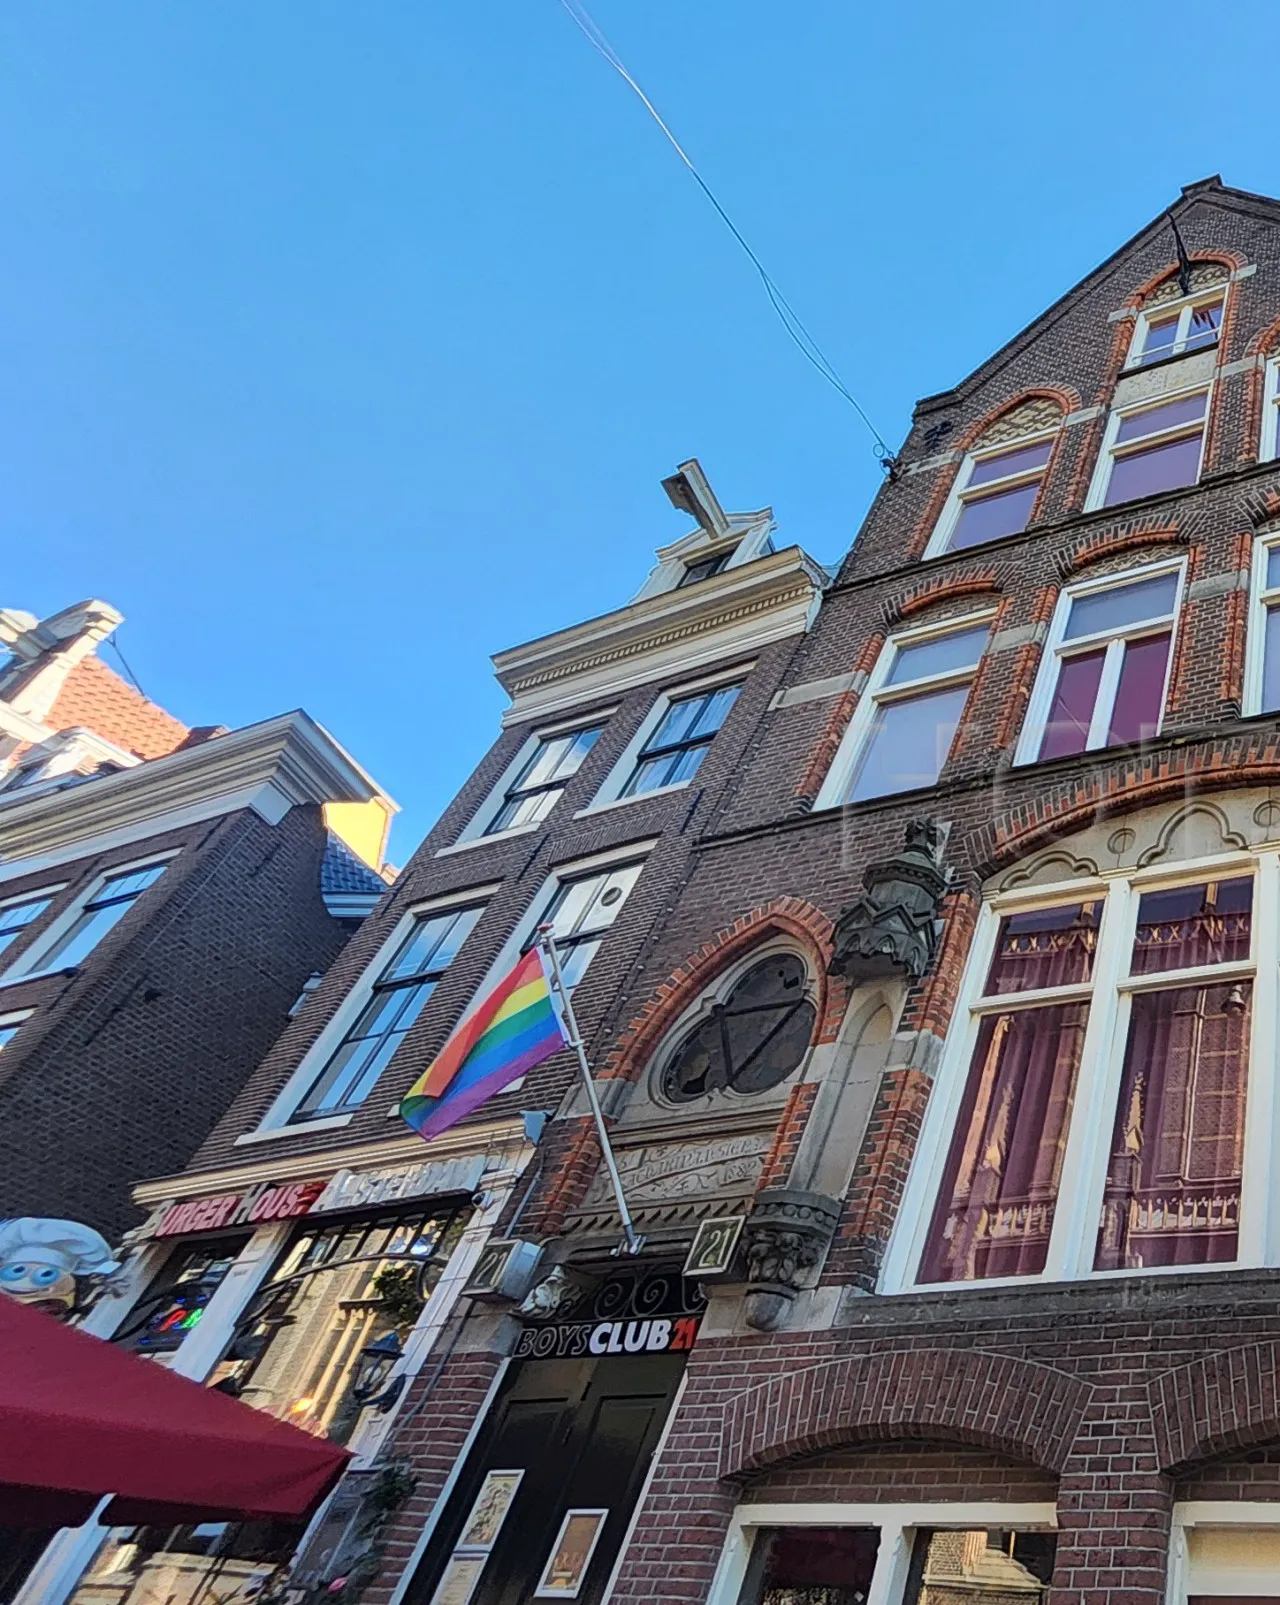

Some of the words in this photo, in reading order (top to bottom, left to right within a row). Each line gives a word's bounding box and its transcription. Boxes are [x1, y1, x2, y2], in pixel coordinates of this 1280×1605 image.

[138, 1198, 238, 1240] BURGER
[699, 1229, 731, 1267] 21
[475, 1251, 508, 1289] 21
